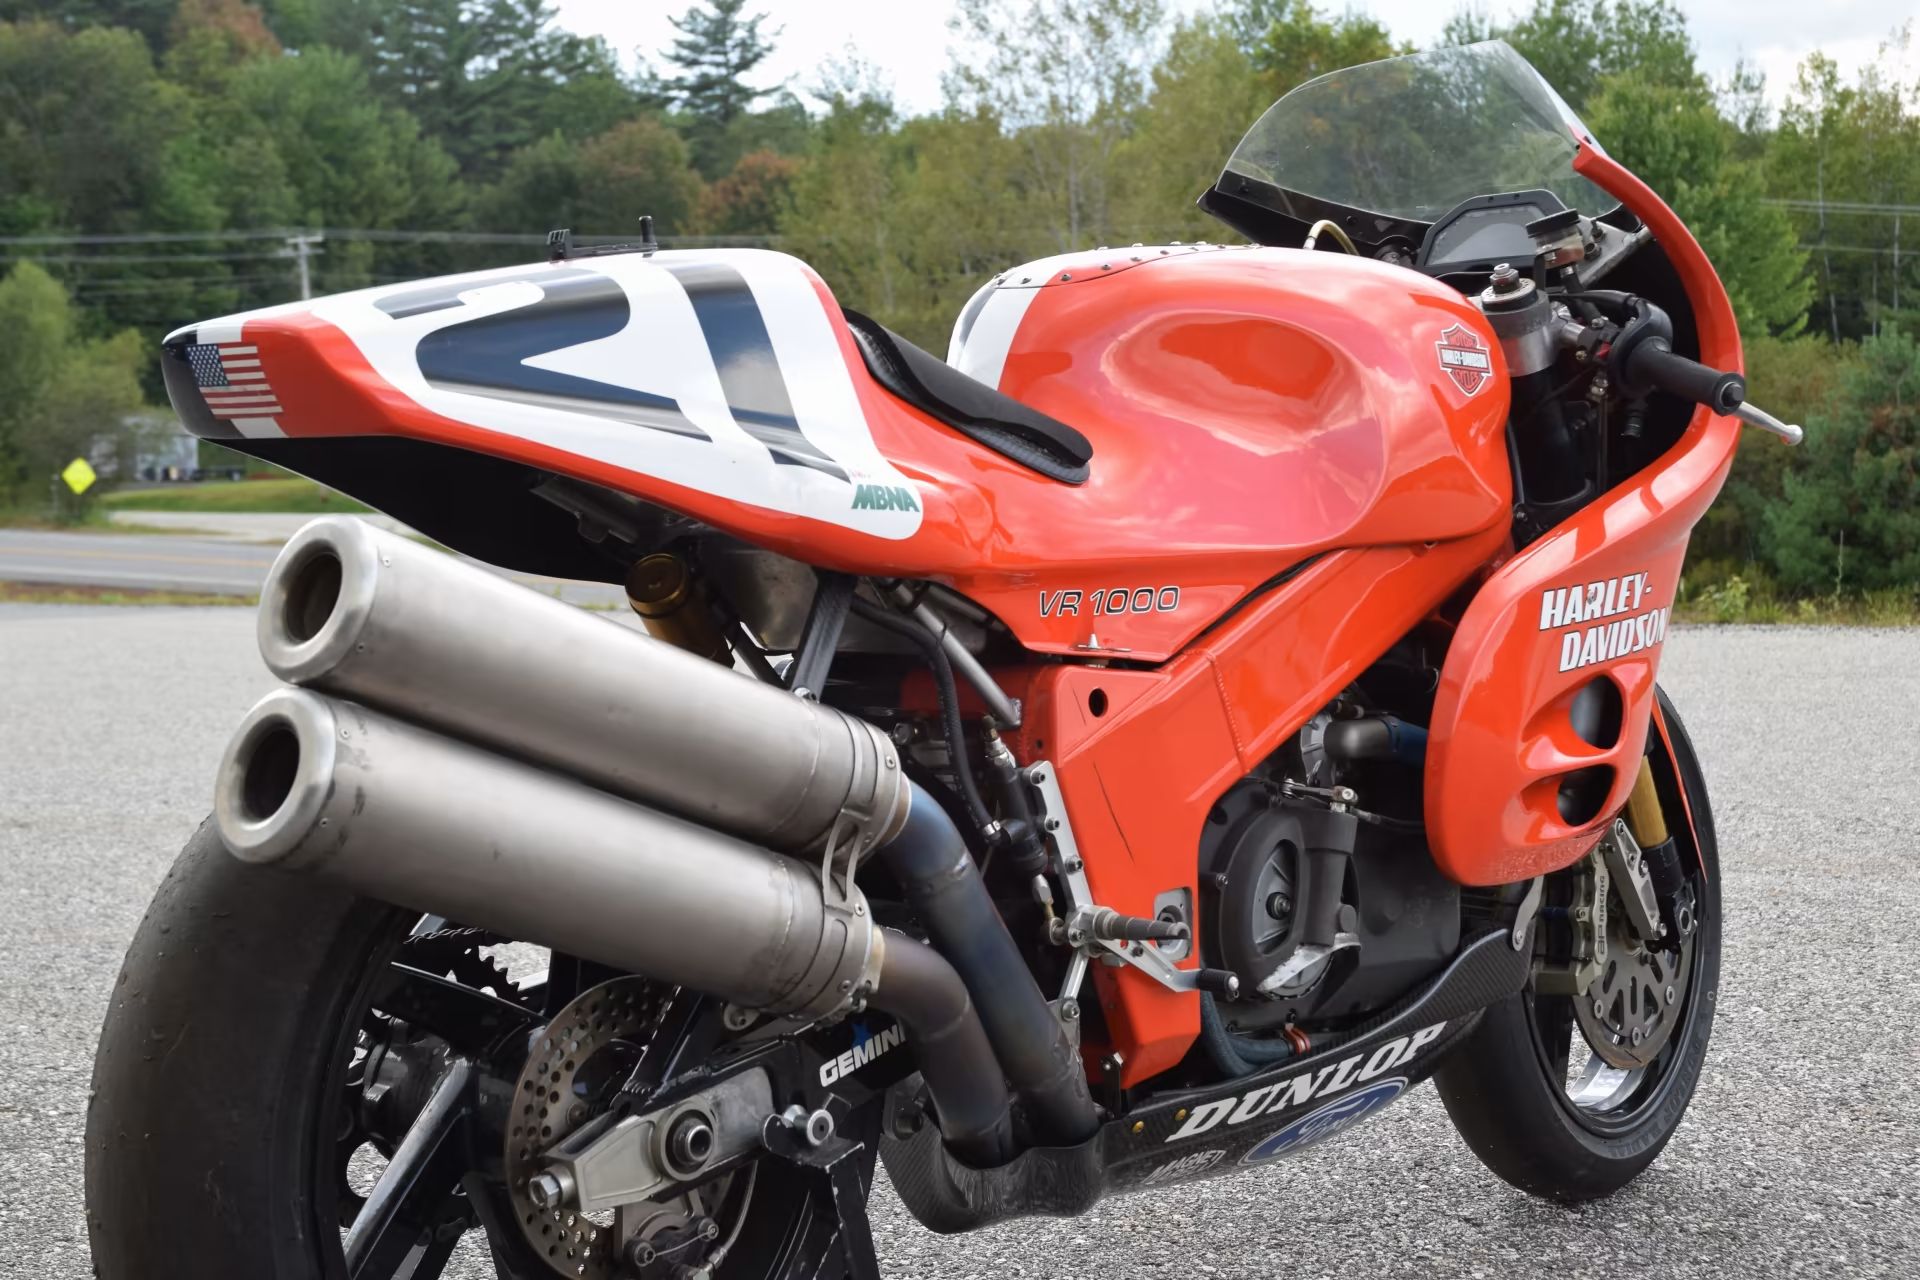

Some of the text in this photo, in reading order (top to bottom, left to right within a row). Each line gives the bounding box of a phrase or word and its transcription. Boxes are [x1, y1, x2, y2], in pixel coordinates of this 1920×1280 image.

[851, 484, 920, 512] MBNA
[1039, 585, 1180, 617] VR 1000
[1539, 571, 1652, 631] HARLEY-
[1559, 606, 1670, 673] DAVIDSON
[1164, 1021, 1447, 1142] DUNLOP
